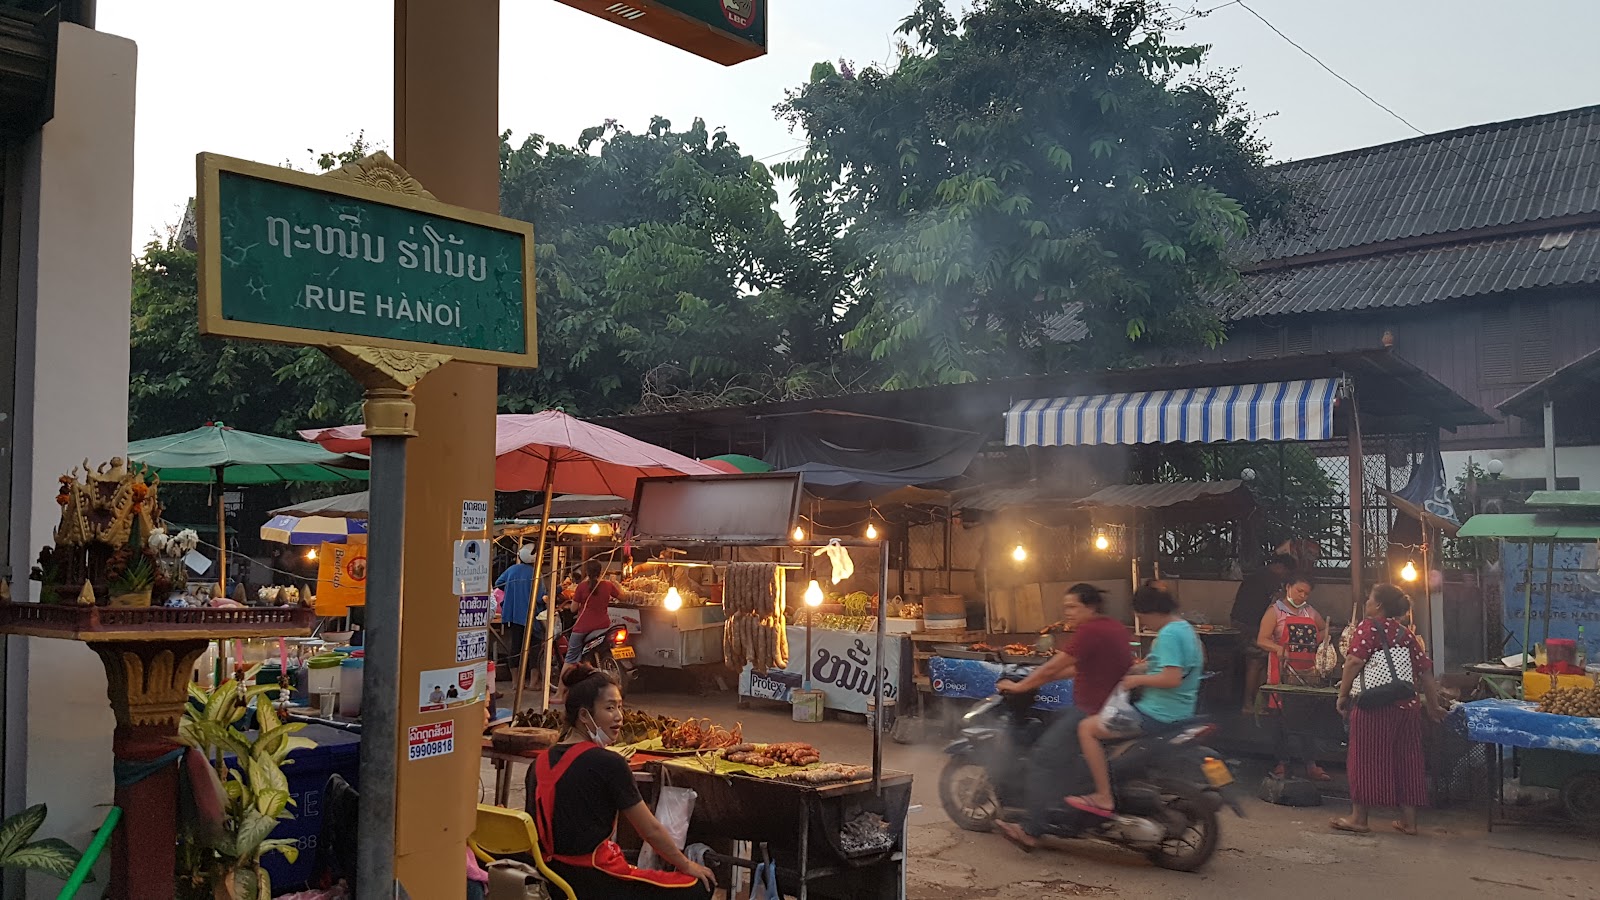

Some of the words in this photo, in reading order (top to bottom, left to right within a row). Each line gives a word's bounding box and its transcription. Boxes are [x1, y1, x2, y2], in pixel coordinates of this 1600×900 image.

[728, 12, 747, 26] LBC
[305, 284, 367, 315] RUE
[752, 674, 786, 697] Protex
[945, 682, 967, 692] pepsi
[410, 739, 452, 759] 59909818
